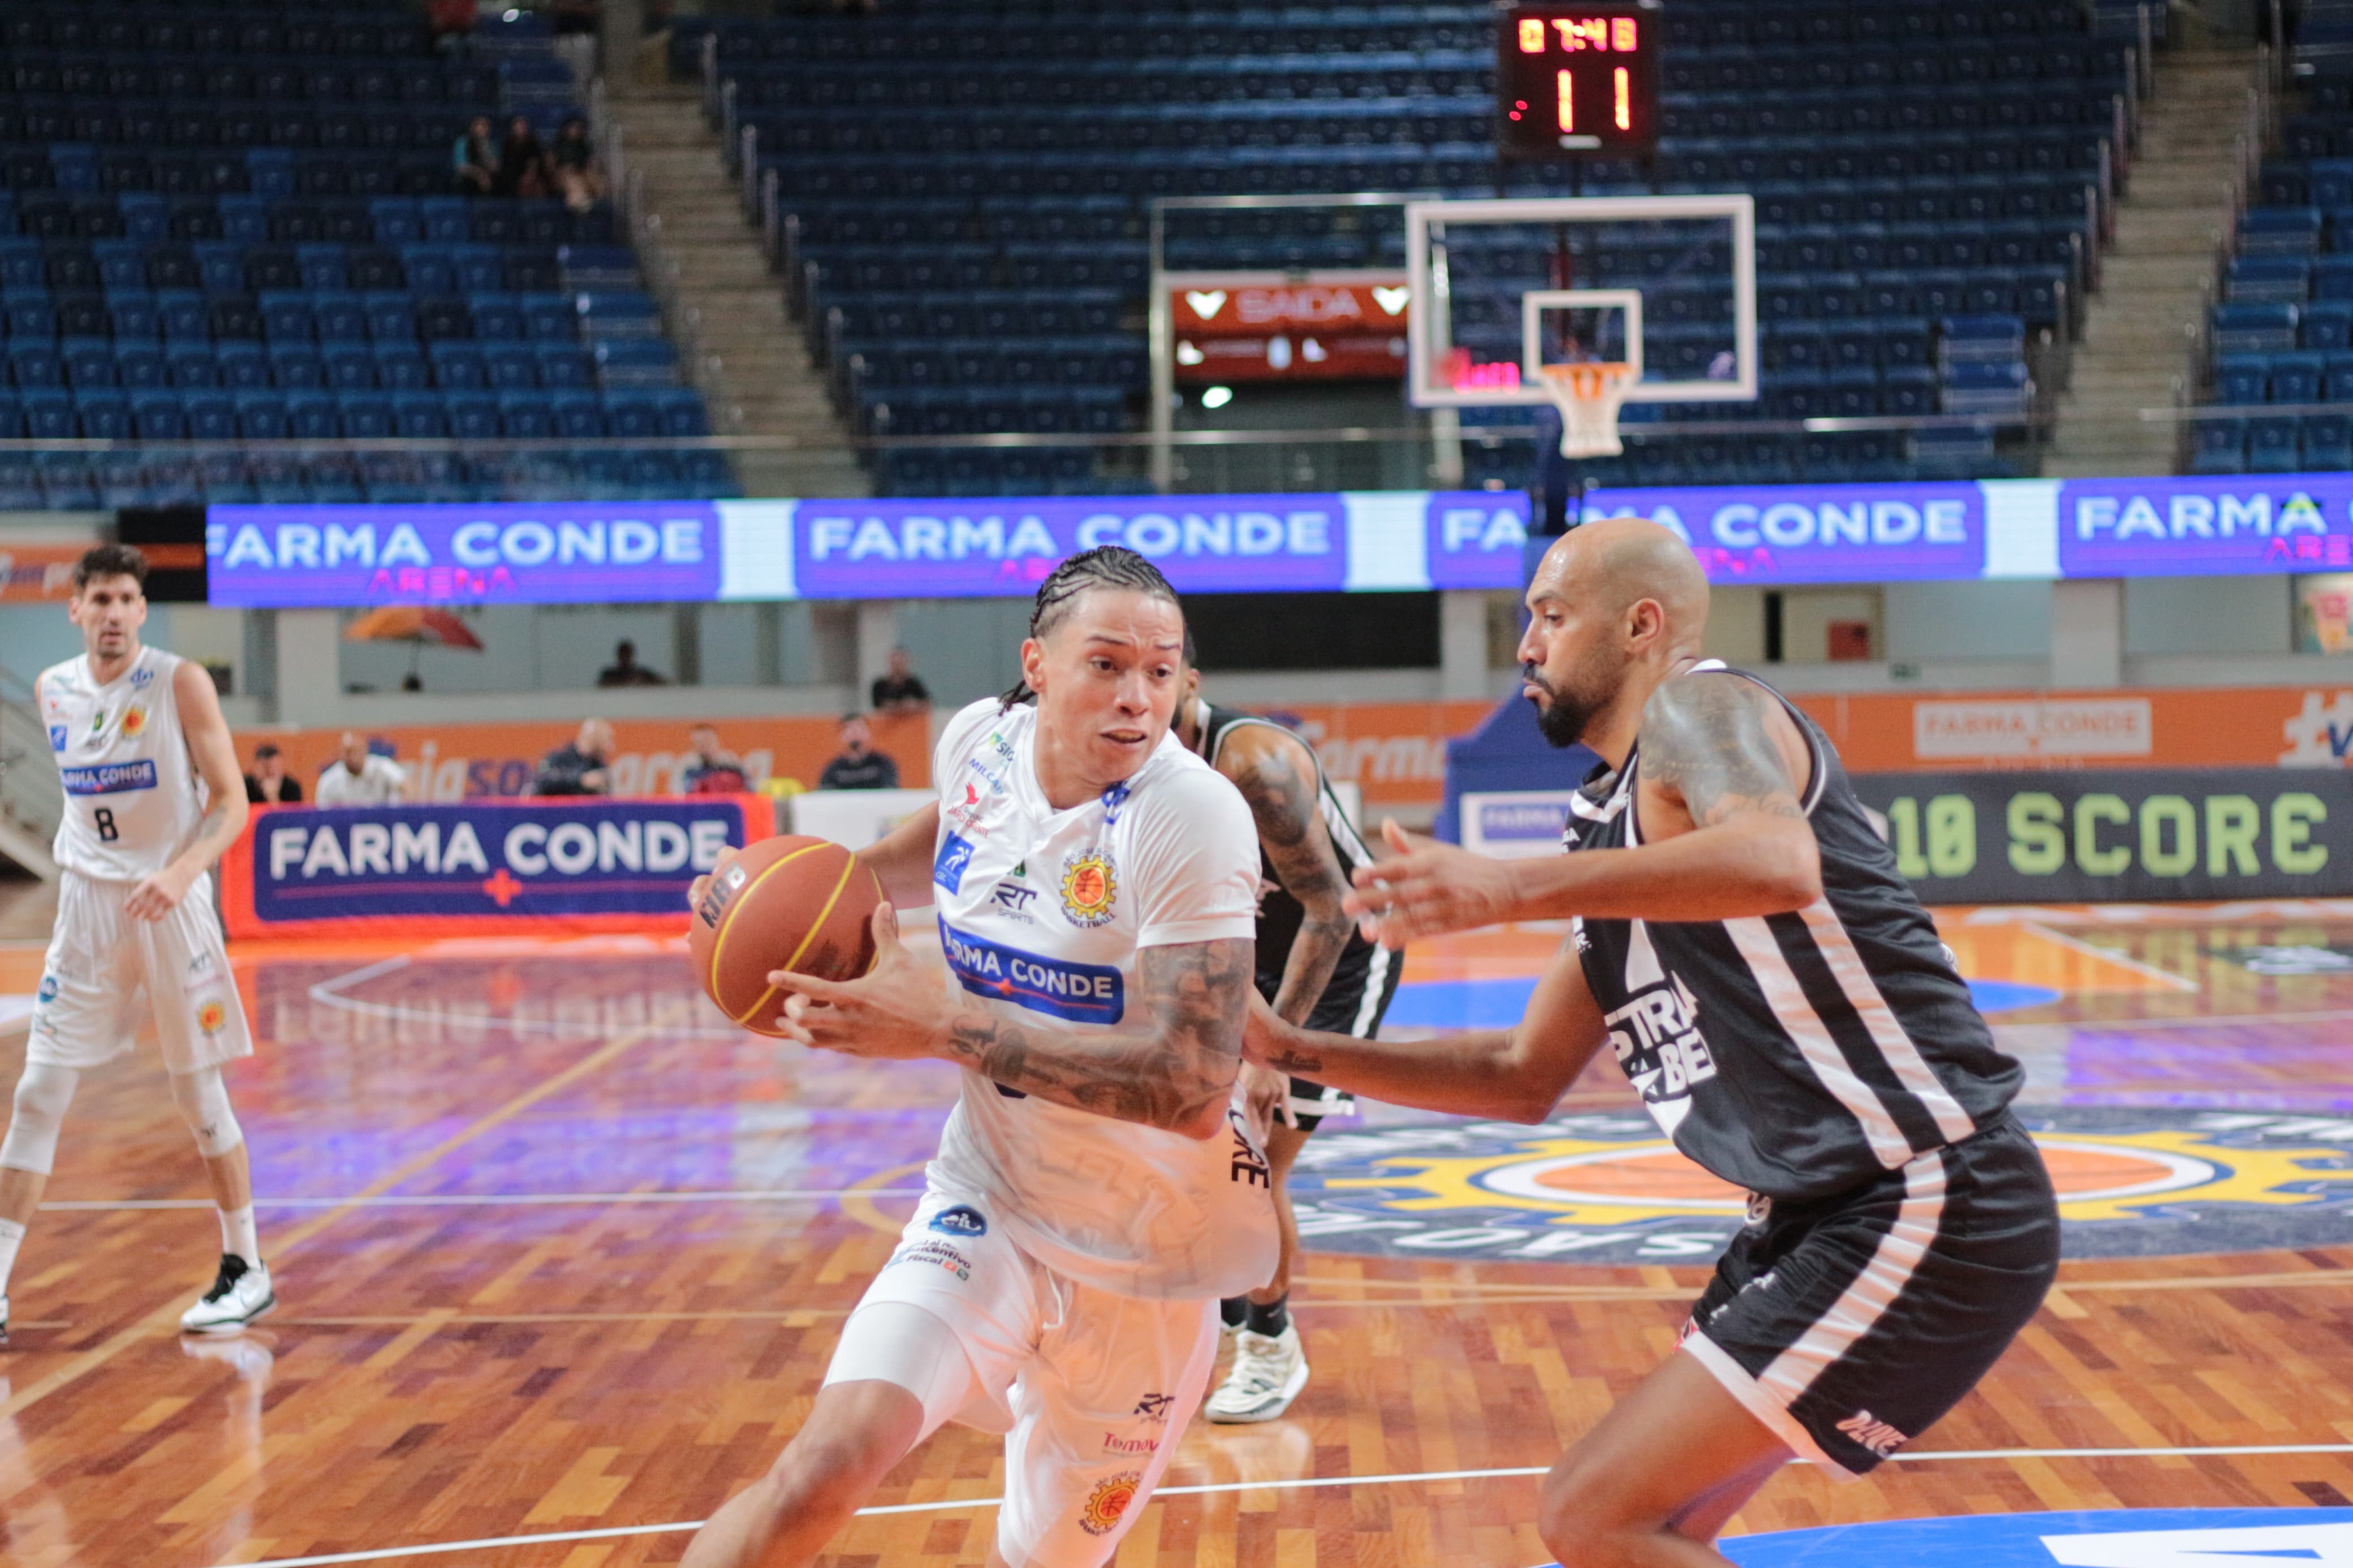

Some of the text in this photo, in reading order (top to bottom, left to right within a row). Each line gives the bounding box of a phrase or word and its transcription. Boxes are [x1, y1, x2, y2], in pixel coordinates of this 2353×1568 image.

[810, 511, 1331, 560] FARMA CONDE
[1711, 499, 1967, 547] CONDE
[2075, 492, 2328, 541] FARMA
[451, 519, 704, 565] CONDE
[368, 567, 518, 598] ARENA
[94, 807, 119, 841] 8
[1888, 792, 2329, 879] 10 SCORE
[270, 820, 730, 880] FARMA CONDE
[998, 907, 1035, 926] SPORTS
[1061, 905, 1118, 929] BASKETBALL
[1010, 958, 1114, 999] CONDE
